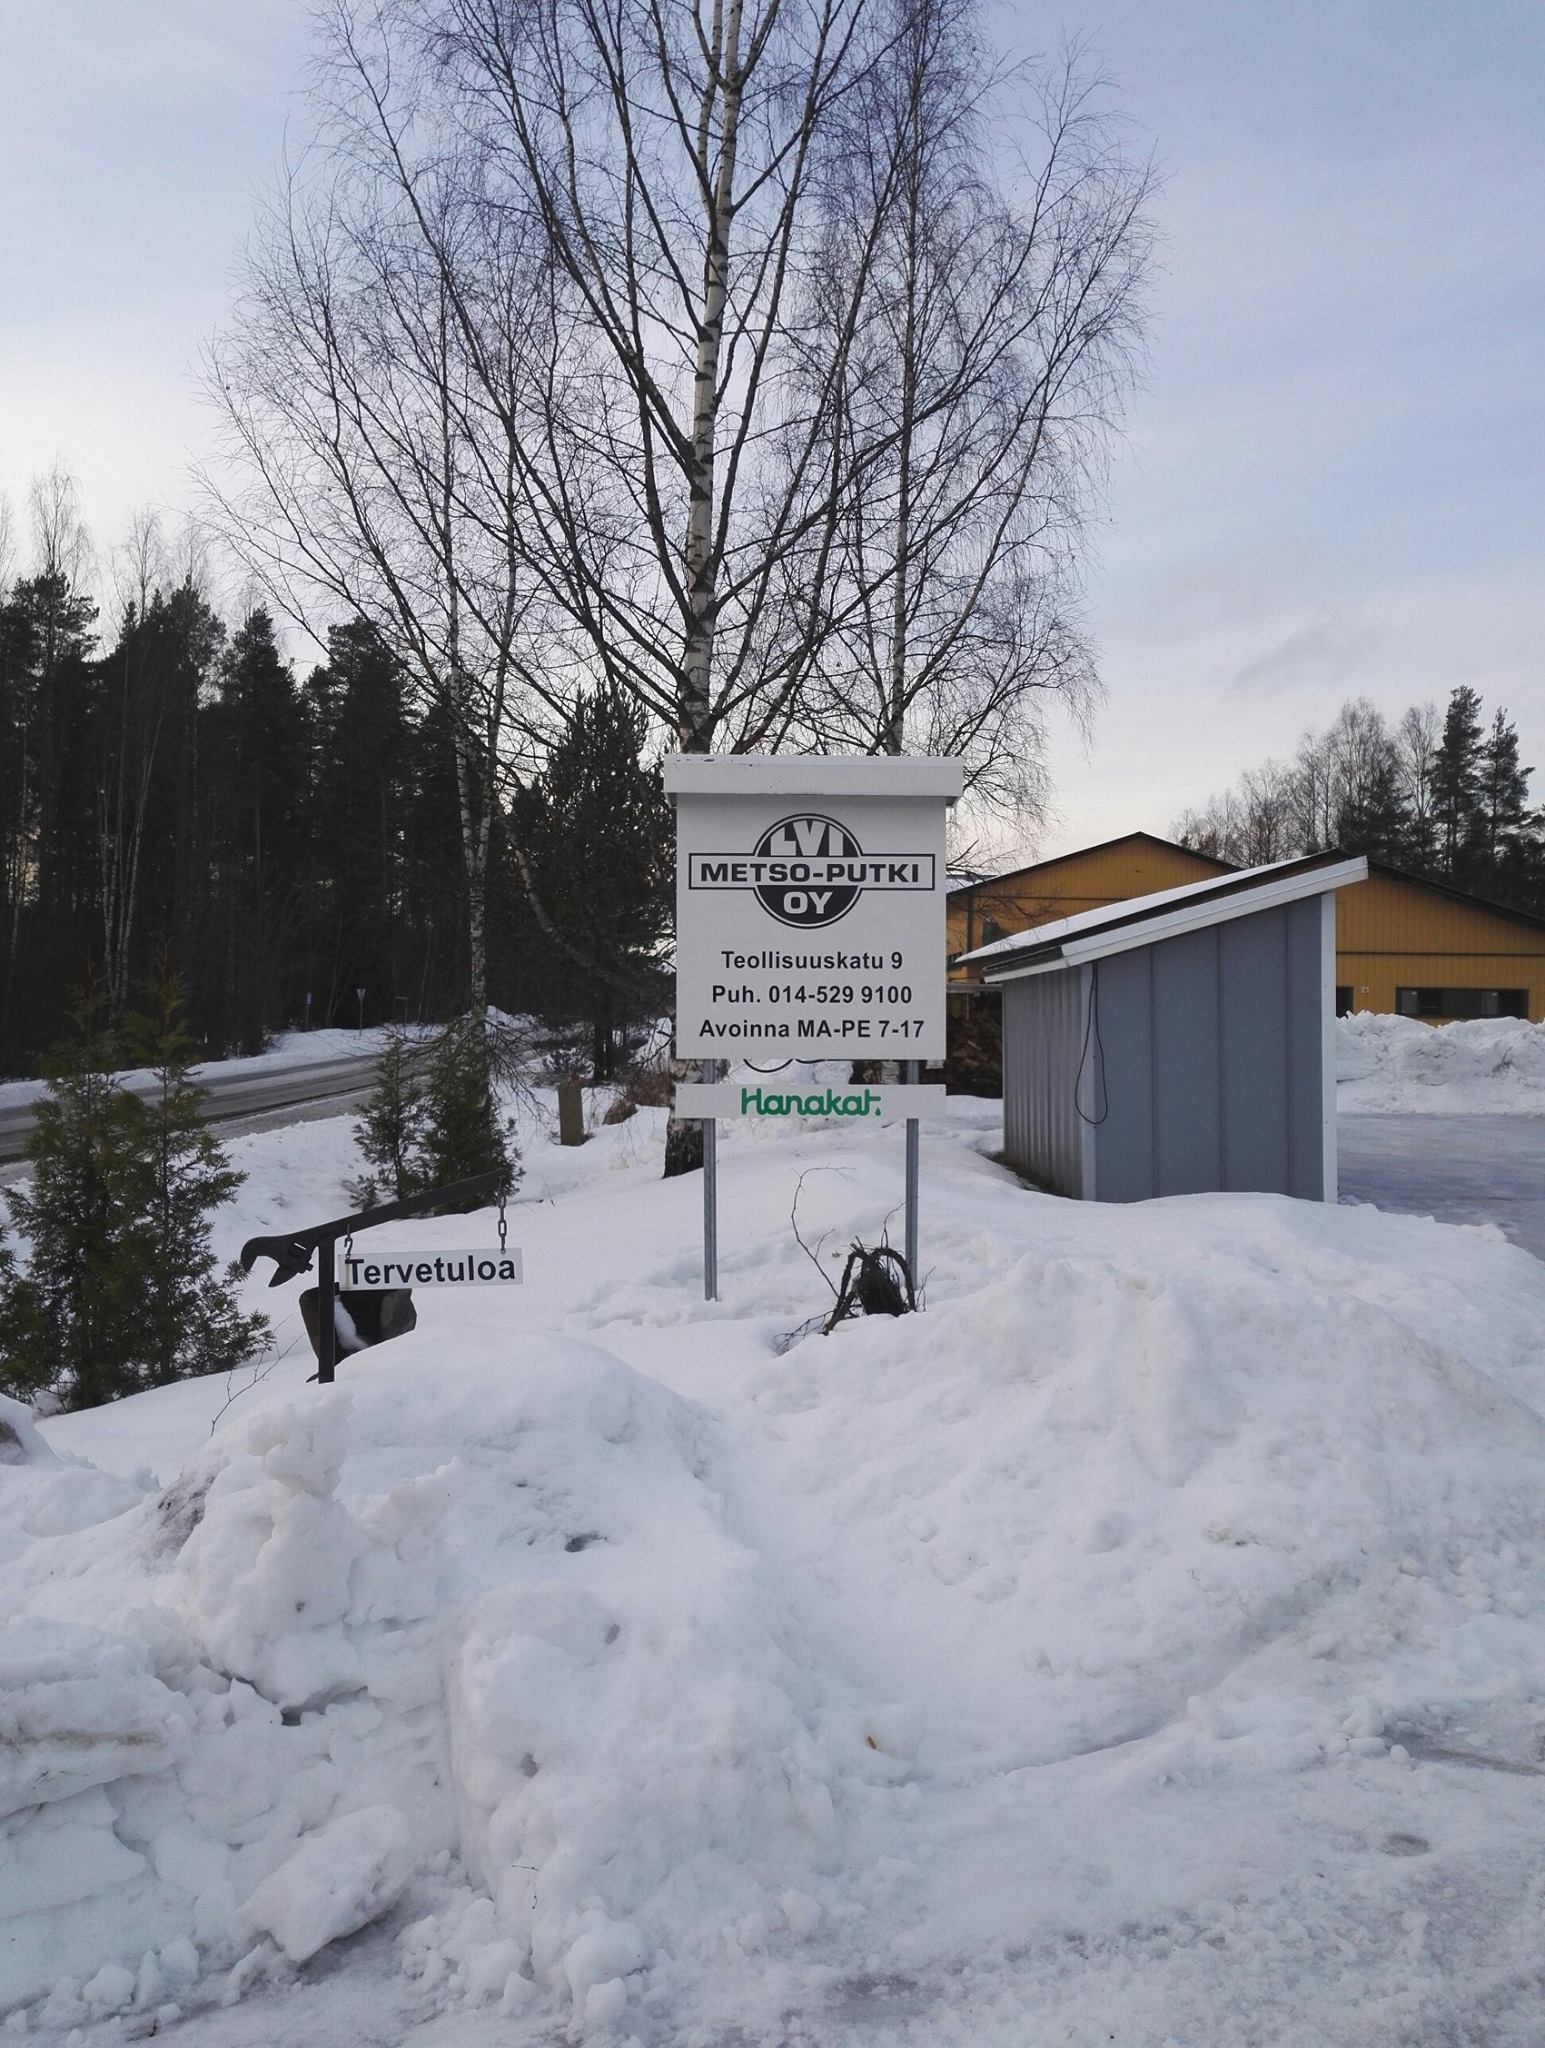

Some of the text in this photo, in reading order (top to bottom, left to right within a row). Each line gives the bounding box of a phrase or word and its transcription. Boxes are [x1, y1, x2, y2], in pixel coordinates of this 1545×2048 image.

[700, 863, 919, 883] METSO-PUTKI
[783, 891, 833, 915] OY
[721, 951, 903, 970] Teollisuuskatu 9
[712, 985, 912, 1004] Puh. 014-529 9100
[699, 1020, 925, 1038] Avoinna MA-PE 7-17
[741, 1088, 882, 1116] Hanakat
[345, 1255, 515, 1285] Tervetuloa
